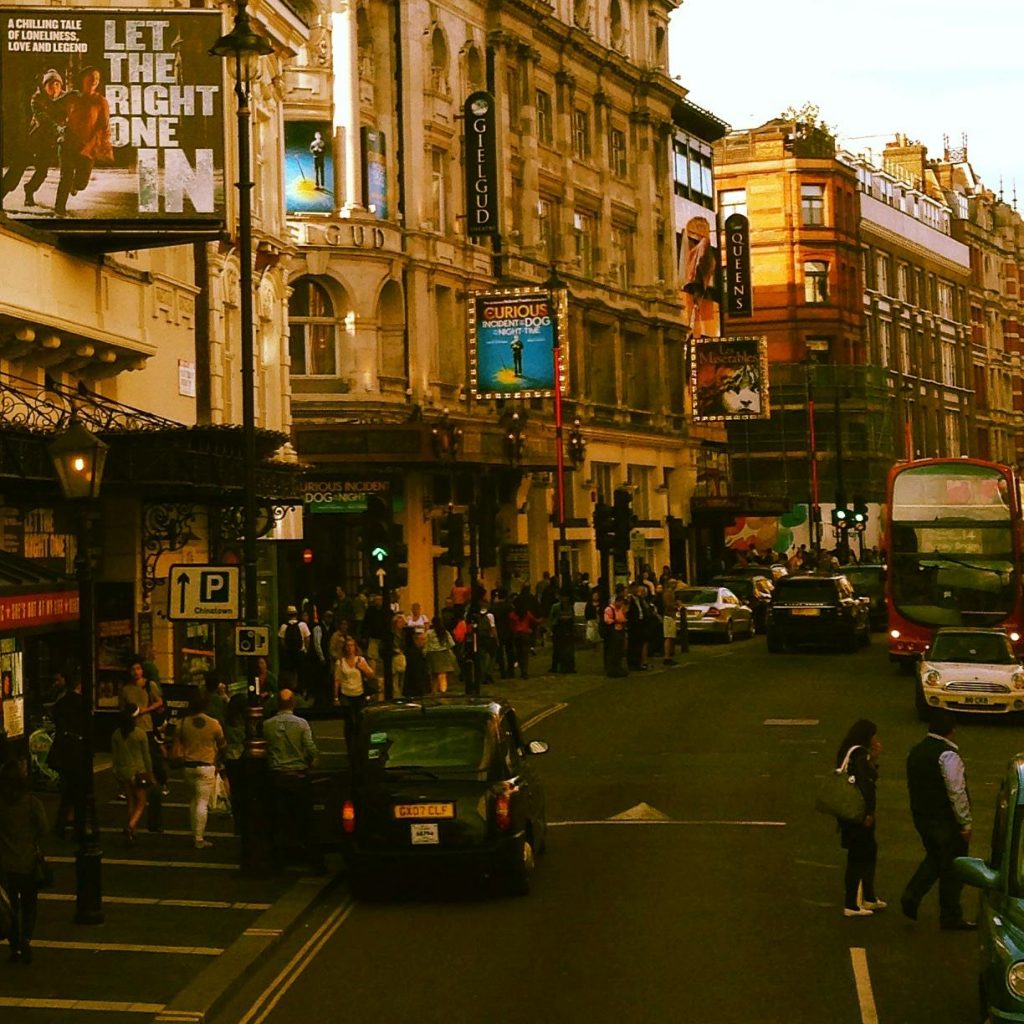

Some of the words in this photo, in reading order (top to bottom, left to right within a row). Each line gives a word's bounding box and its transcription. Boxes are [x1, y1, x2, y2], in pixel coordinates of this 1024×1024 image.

[8, 19, 15, 29] A
[15, 19, 59, 30] CHILLING
[60, 19, 82, 30] TALE
[8, 30, 20, 40] OF
[21, 30, 80, 42] LONELINESS,
[104, 20, 170, 51] LET
[8, 41, 31, 52] LOVE
[32, 42, 51, 53] AND
[53, 43, 88, 53] LEGEND
[104, 53, 176, 83] THE
[105, 85, 219, 116] RIGHT
[108, 117, 179, 147] ONE
[473, 118, 490, 224] GIELGUD
[138, 148, 215, 213] IN
[731, 232, 744, 310] QUEENS
[484, 303, 547, 320] CURIOUS
[482, 319, 519, 328] INCIDENT
[524, 316, 550, 327] DOG
[719, 344, 735, 355] Les
[344, 481, 390, 492] INCIDENT
[305, 492, 333, 503] DOG
[206, 574, 225, 600] P
[195, 607, 233, 615] Chinatown
